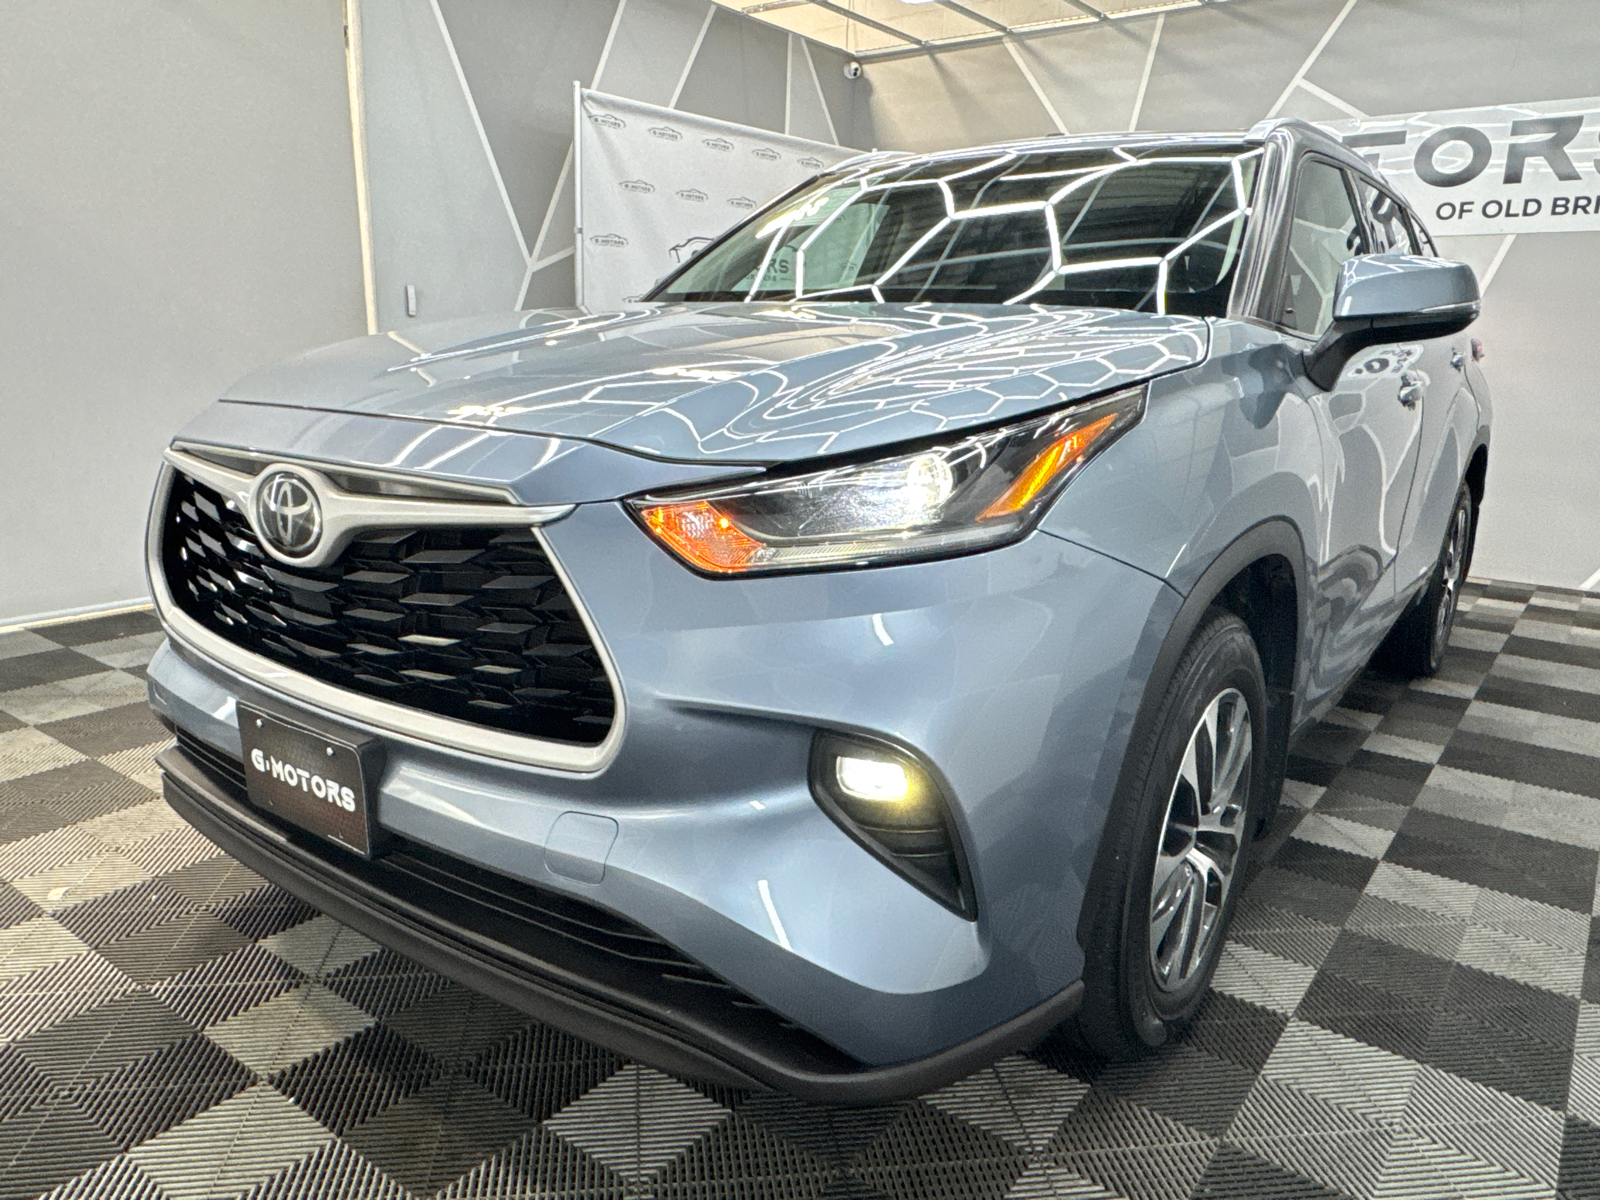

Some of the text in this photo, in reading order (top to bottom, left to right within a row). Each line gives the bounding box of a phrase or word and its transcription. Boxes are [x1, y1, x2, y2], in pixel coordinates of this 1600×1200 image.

[1341, 114, 1600, 187] TOR
[1435, 201, 1475, 220] OF
[1481, 198, 1542, 218] OLD
